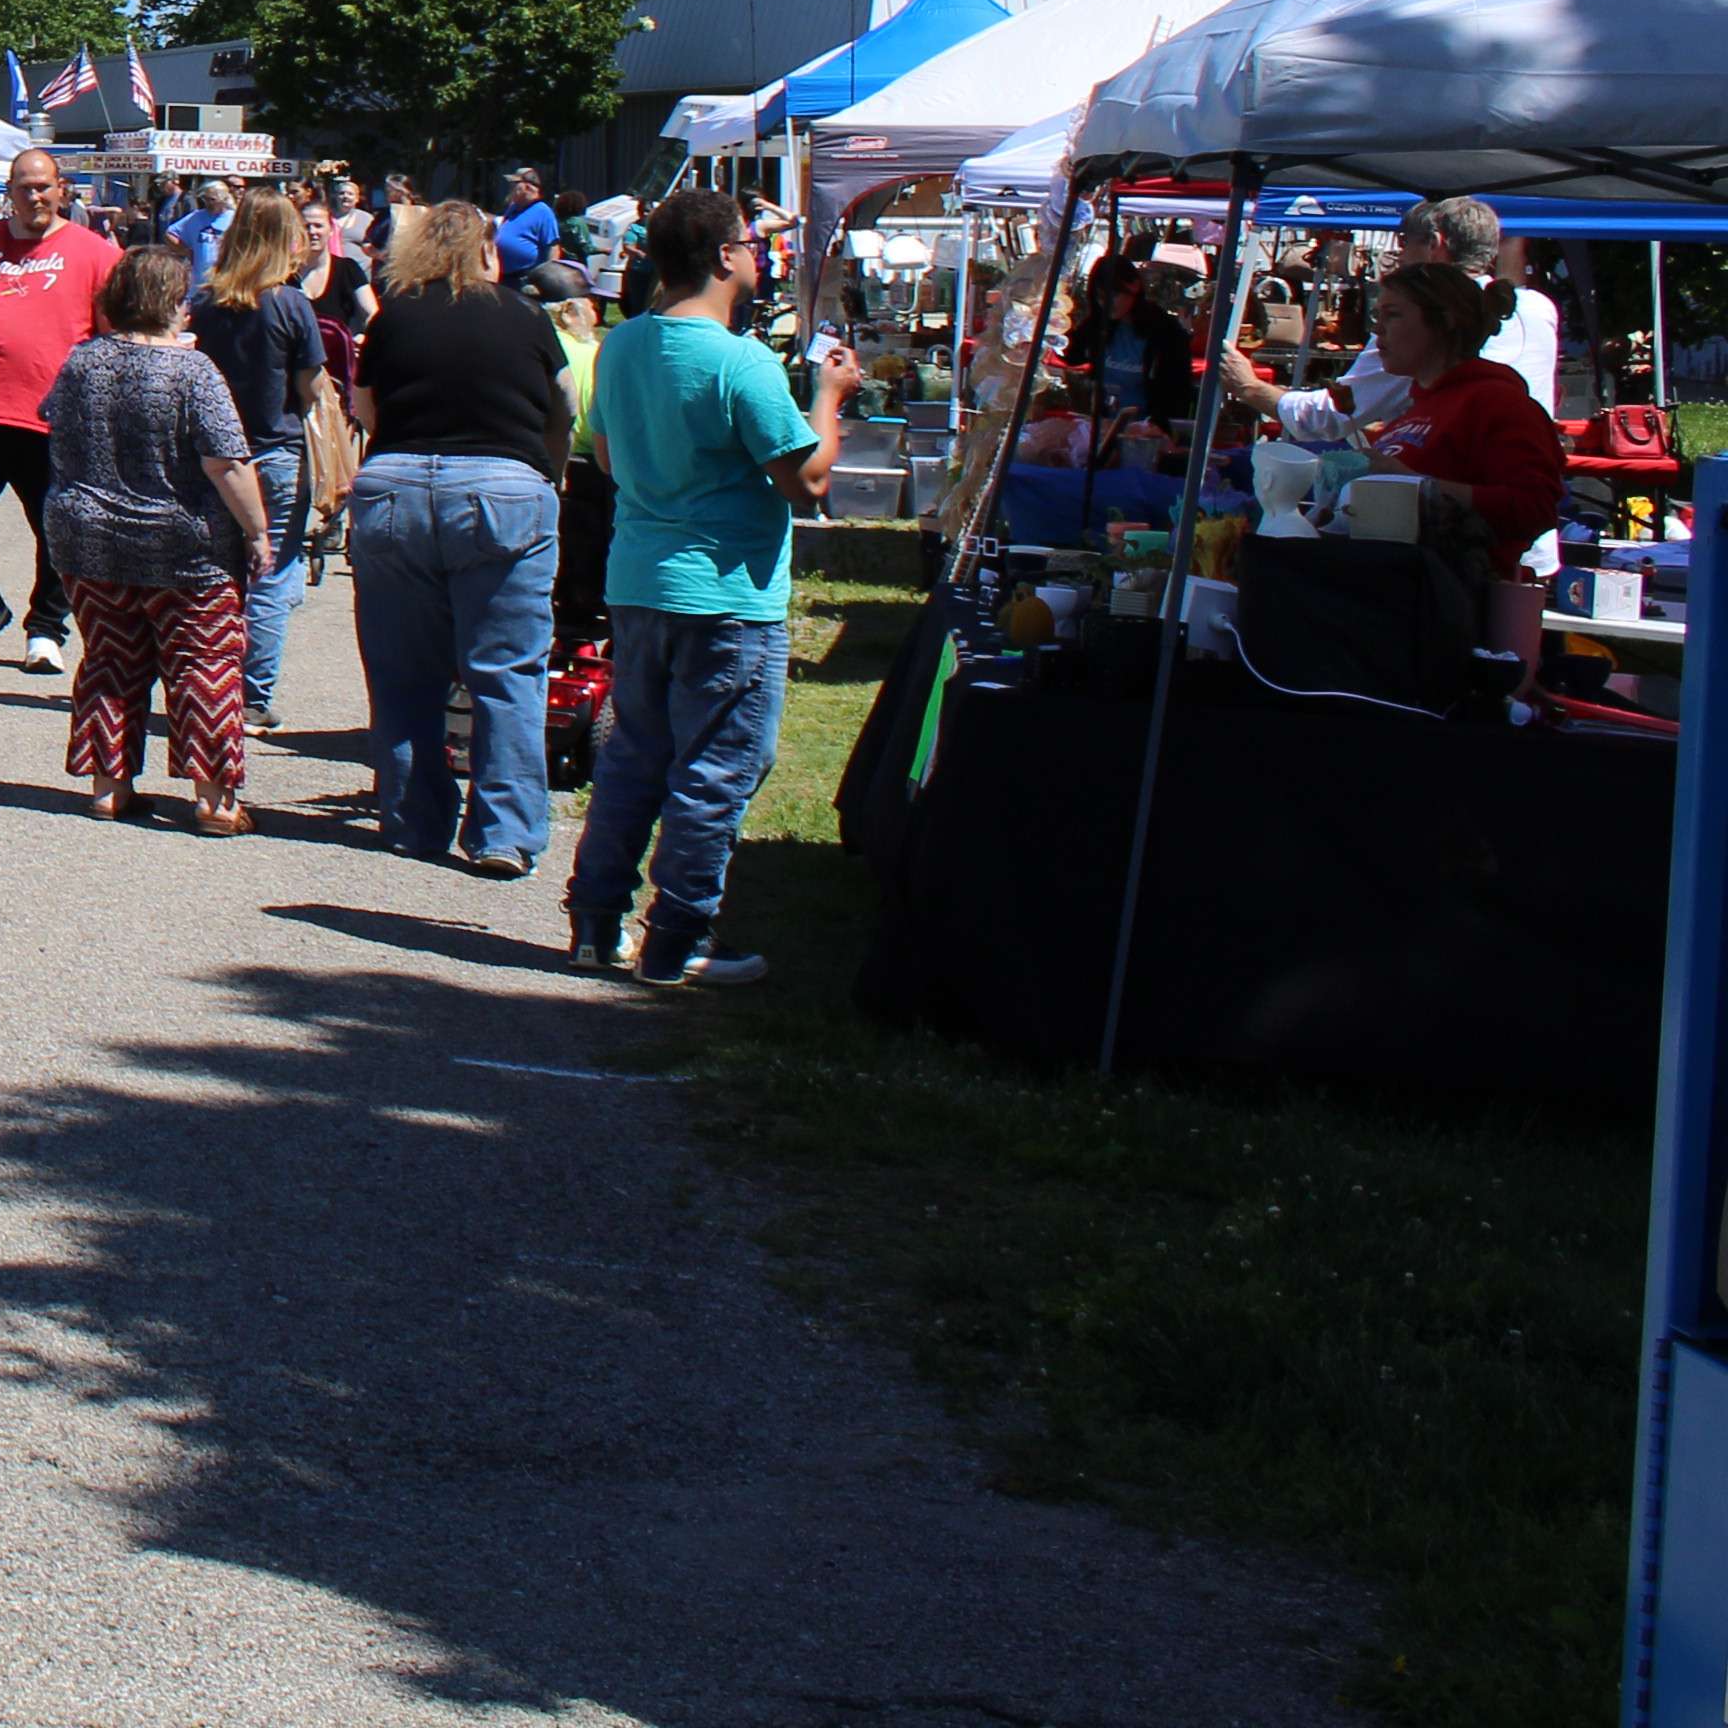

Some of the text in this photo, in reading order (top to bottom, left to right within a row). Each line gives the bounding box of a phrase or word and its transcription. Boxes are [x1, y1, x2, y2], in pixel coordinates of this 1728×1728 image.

[164, 158, 293, 174] FUNNEL CAKES
[42, 272, 57, 290] 7
